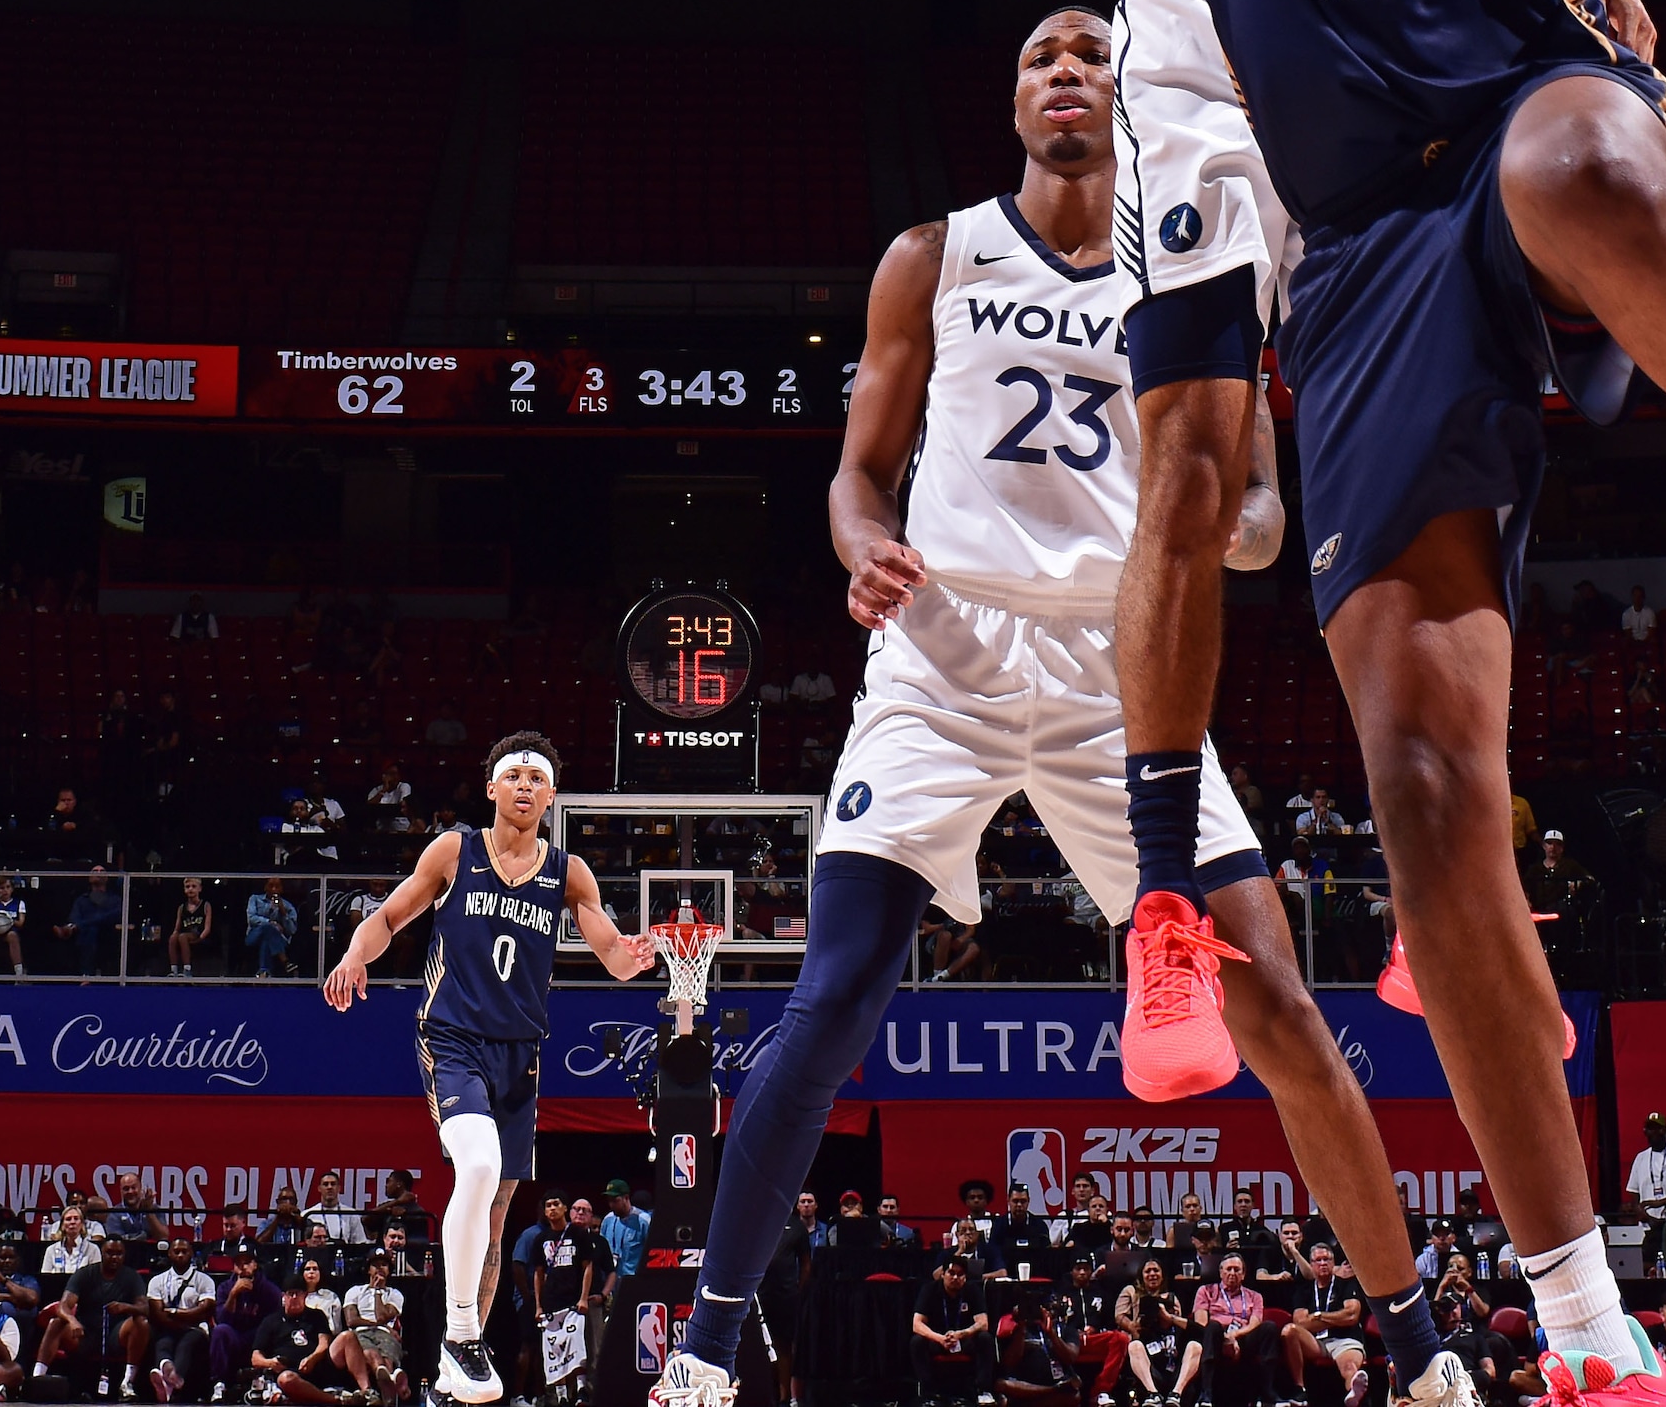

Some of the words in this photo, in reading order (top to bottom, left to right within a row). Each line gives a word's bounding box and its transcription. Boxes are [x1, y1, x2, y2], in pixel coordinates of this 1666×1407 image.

[968, 298, 1131, 357] WOLV
[277, 350, 458, 373] Timberwolves
[510, 360, 536, 392] 2
[99, 358, 197, 401] LEAGUE
[337, 375, 405, 415] 62
[585, 367, 605, 392] 3
[637, 369, 748, 407] 3:43
[776, 368, 797, 393] 2
[510, 398, 534, 414] TOL
[578, 396, 608, 413] FLS
[772, 397, 802, 415] FLS
[984, 365, 1123, 472] 23
[19, 450, 85, 476] Yes!
[667, 616, 733, 647] 3:43
[675, 650, 726, 706] 16
[665, 731, 744, 747] TISSOT
[465, 891, 496, 918] NEW
[500, 896, 555, 936] ORLEANS
[491, 934, 517, 983] 0
[51, 1014, 269, 1086] Courtside
[887, 1021, 1123, 1074] ULTRA
[1080, 1128, 1220, 1162] 2K26
[640, 1355, 657, 1372] NBA
